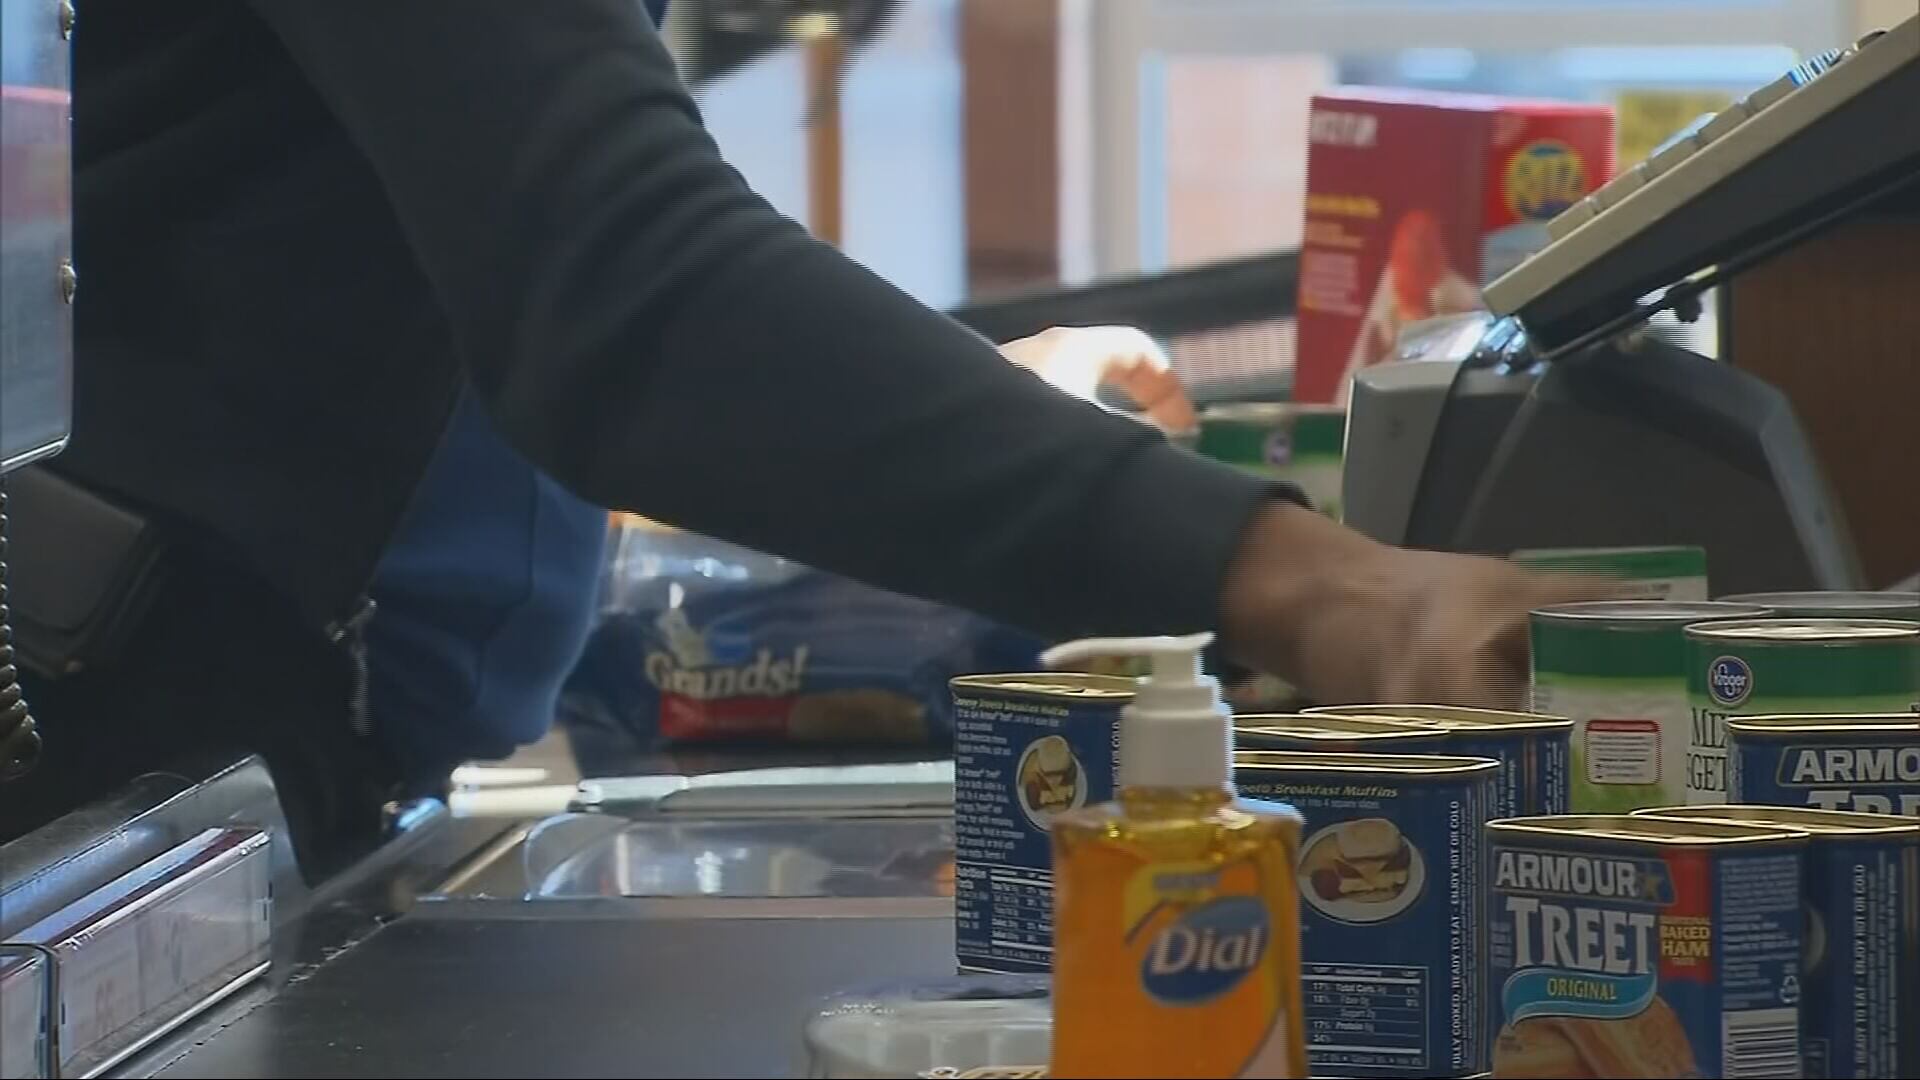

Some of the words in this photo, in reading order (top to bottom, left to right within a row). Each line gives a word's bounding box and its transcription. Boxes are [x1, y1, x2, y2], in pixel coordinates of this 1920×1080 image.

[1713, 663, 1748, 697] Kroger
[1792, 748, 1920, 782] ARMO
[1275, 784, 1340, 796] Breakfast
[1343, 786, 1398, 798] Muffins
[1496, 852, 1637, 897] ARMOUR
[1506, 896, 1655, 975] TREET
[1660, 925, 1711, 940] BAKED
[1661, 941, 1709, 957] HAM
[1151, 926, 1262, 976] Dial
[1547, 978, 1617, 1000] ORIGINAL
